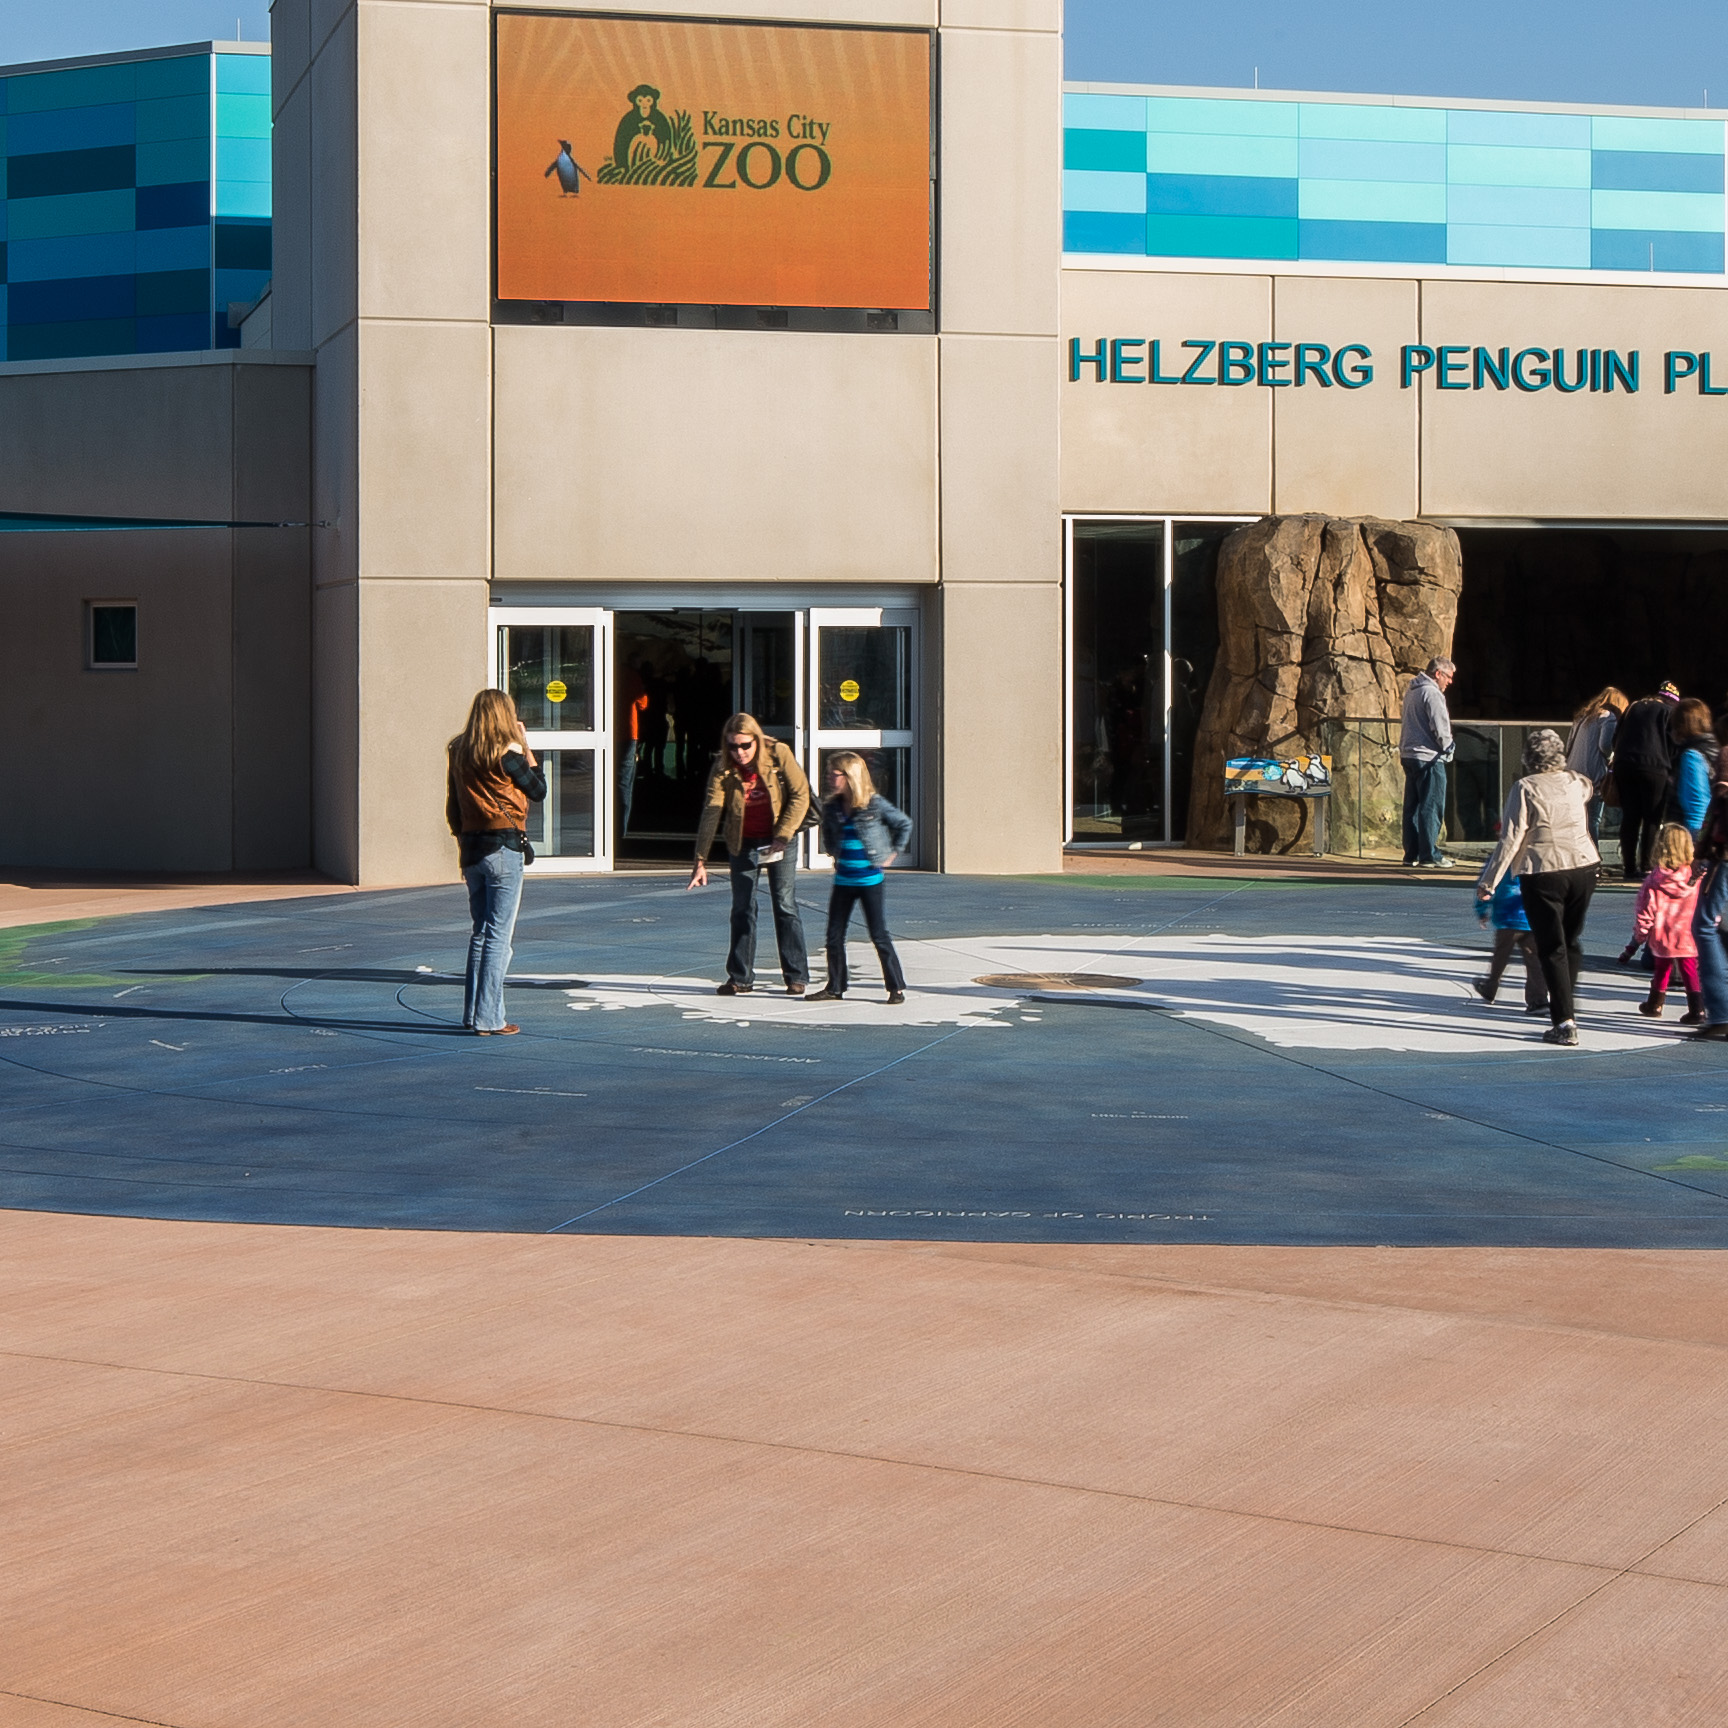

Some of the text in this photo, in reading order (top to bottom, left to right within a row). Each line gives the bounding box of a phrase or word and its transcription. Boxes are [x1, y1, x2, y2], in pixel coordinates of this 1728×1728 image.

[702, 110, 831, 146] Kansas City
[702, 141, 832, 191] ZOO
[1069, 337, 1374, 389] HELZBERG
[1400, 344, 1640, 394] PENGUIN
[844, 1209, 1032, 1218] CAPRICORN
